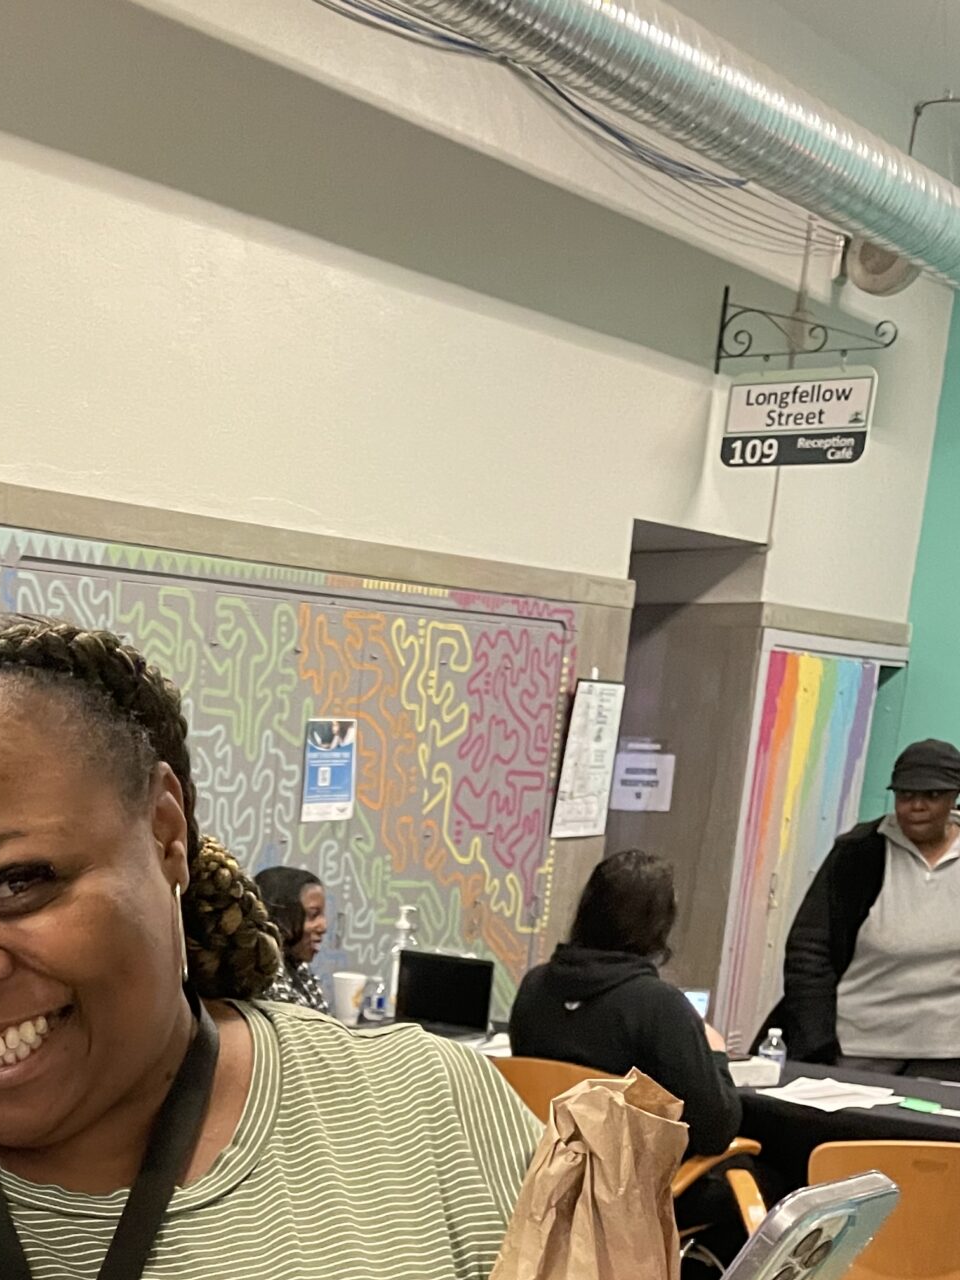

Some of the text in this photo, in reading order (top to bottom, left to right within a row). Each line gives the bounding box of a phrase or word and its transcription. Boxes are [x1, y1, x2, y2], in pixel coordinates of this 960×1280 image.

[746, 385, 853, 409] Longfellow
[765, 409, 825, 427] Street
[797, 435, 855, 449] Reception
[729, 439, 778, 464] 109
[826, 447, 853, 460] Café
